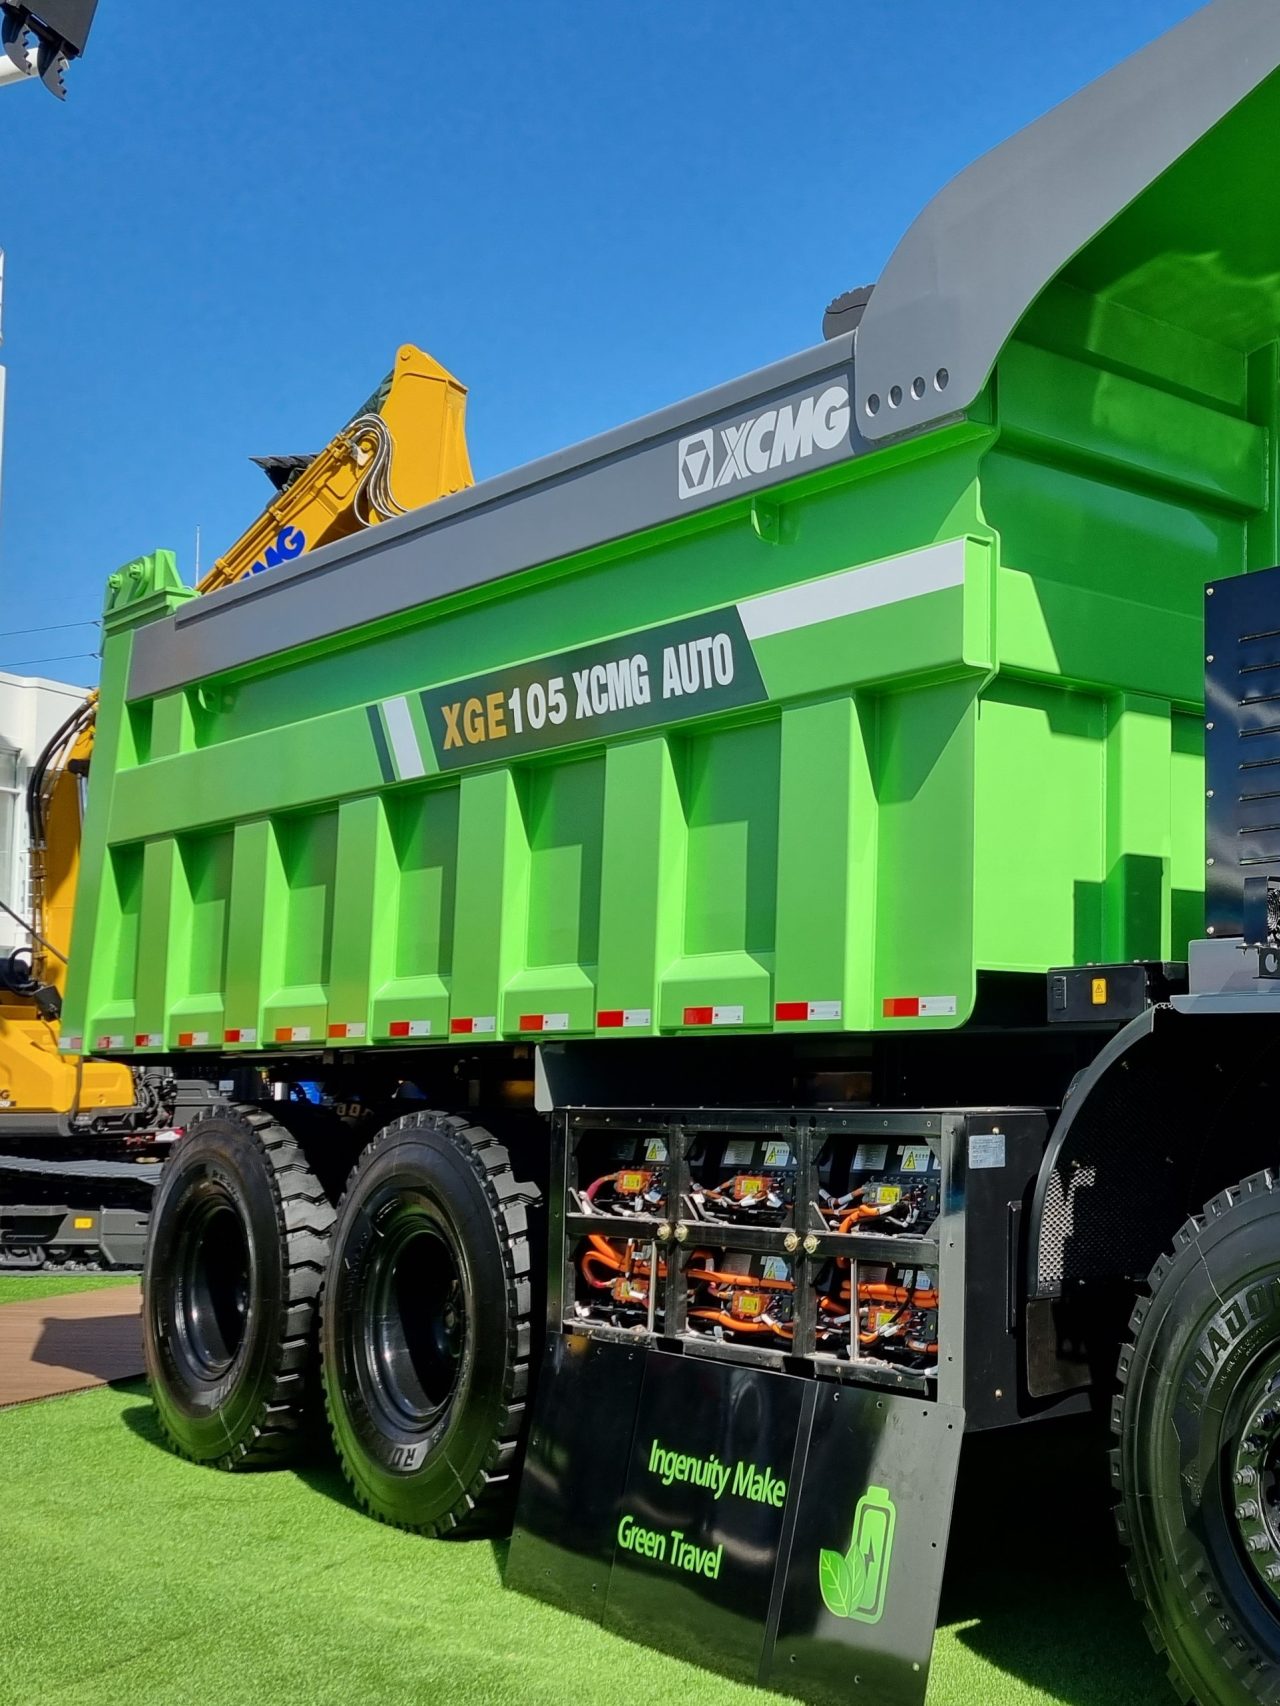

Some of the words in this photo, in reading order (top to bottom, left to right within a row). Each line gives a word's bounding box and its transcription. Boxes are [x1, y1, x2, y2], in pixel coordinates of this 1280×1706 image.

[713, 387, 850, 489] XCMG
[441, 677, 567, 749] XGE105
[572, 654, 651, 719] XCMG
[663, 633, 734, 698] AUTO
[649, 1439, 731, 1500] Ingenuity
[732, 1461, 786, 1507] Make
[618, 1515, 666, 1560] Green
[671, 1530, 723, 1579] Travel
